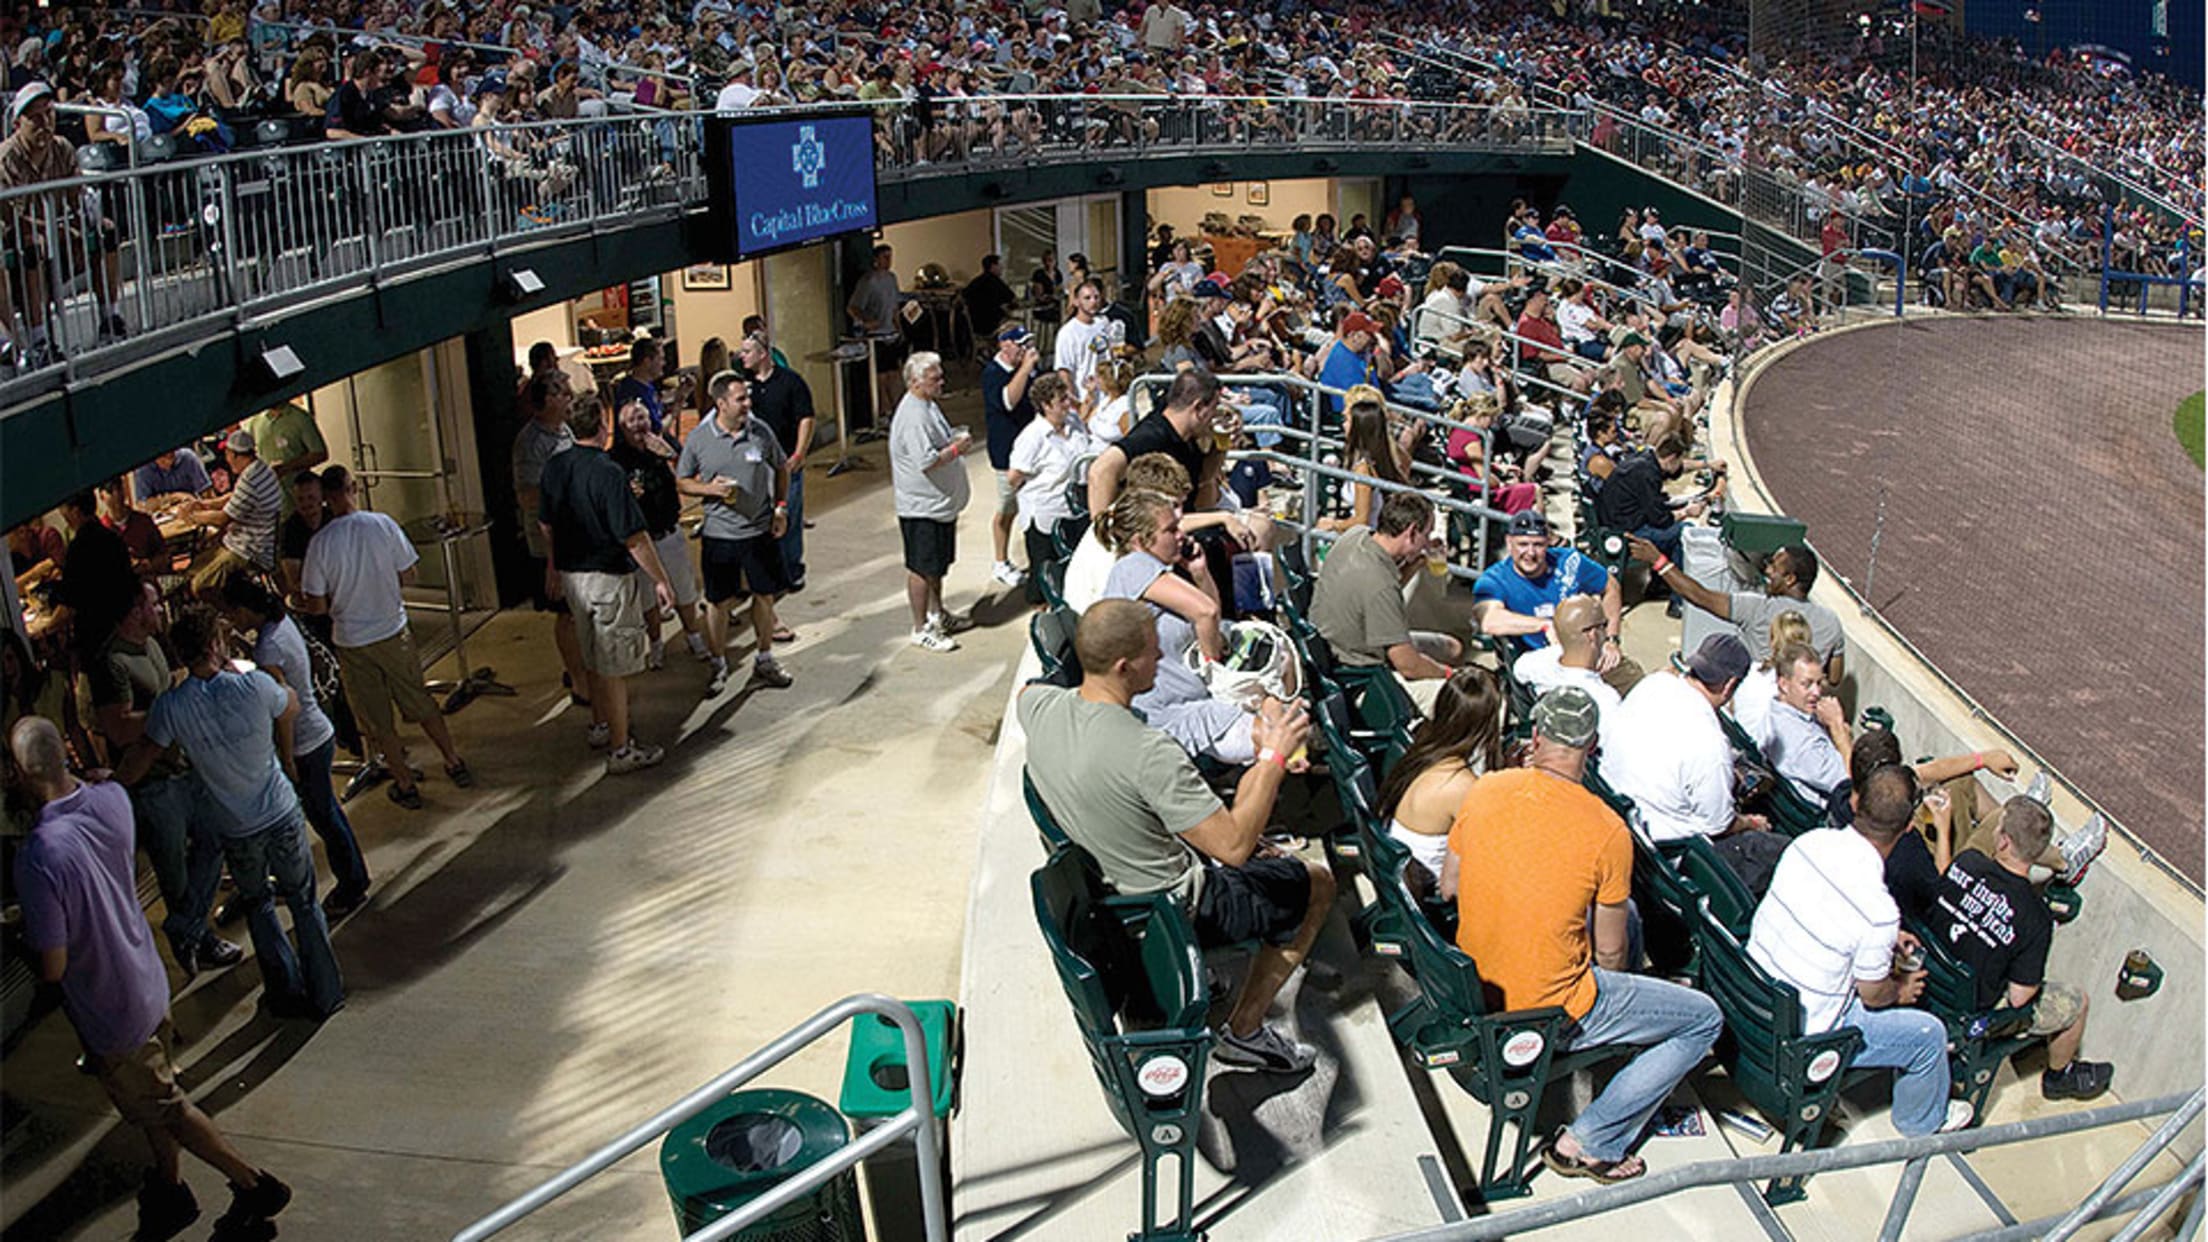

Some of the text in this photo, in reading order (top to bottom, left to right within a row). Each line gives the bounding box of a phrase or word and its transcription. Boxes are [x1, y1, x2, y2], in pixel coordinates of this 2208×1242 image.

[751, 205, 803, 239] Capital
[1972, 877, 2015, 923] inside
[1959, 893, 1985, 919] my
[1981, 903, 2016, 945] head
[1510, 1094, 1522, 1106] A
[1160, 1128, 1173, 1141] A
